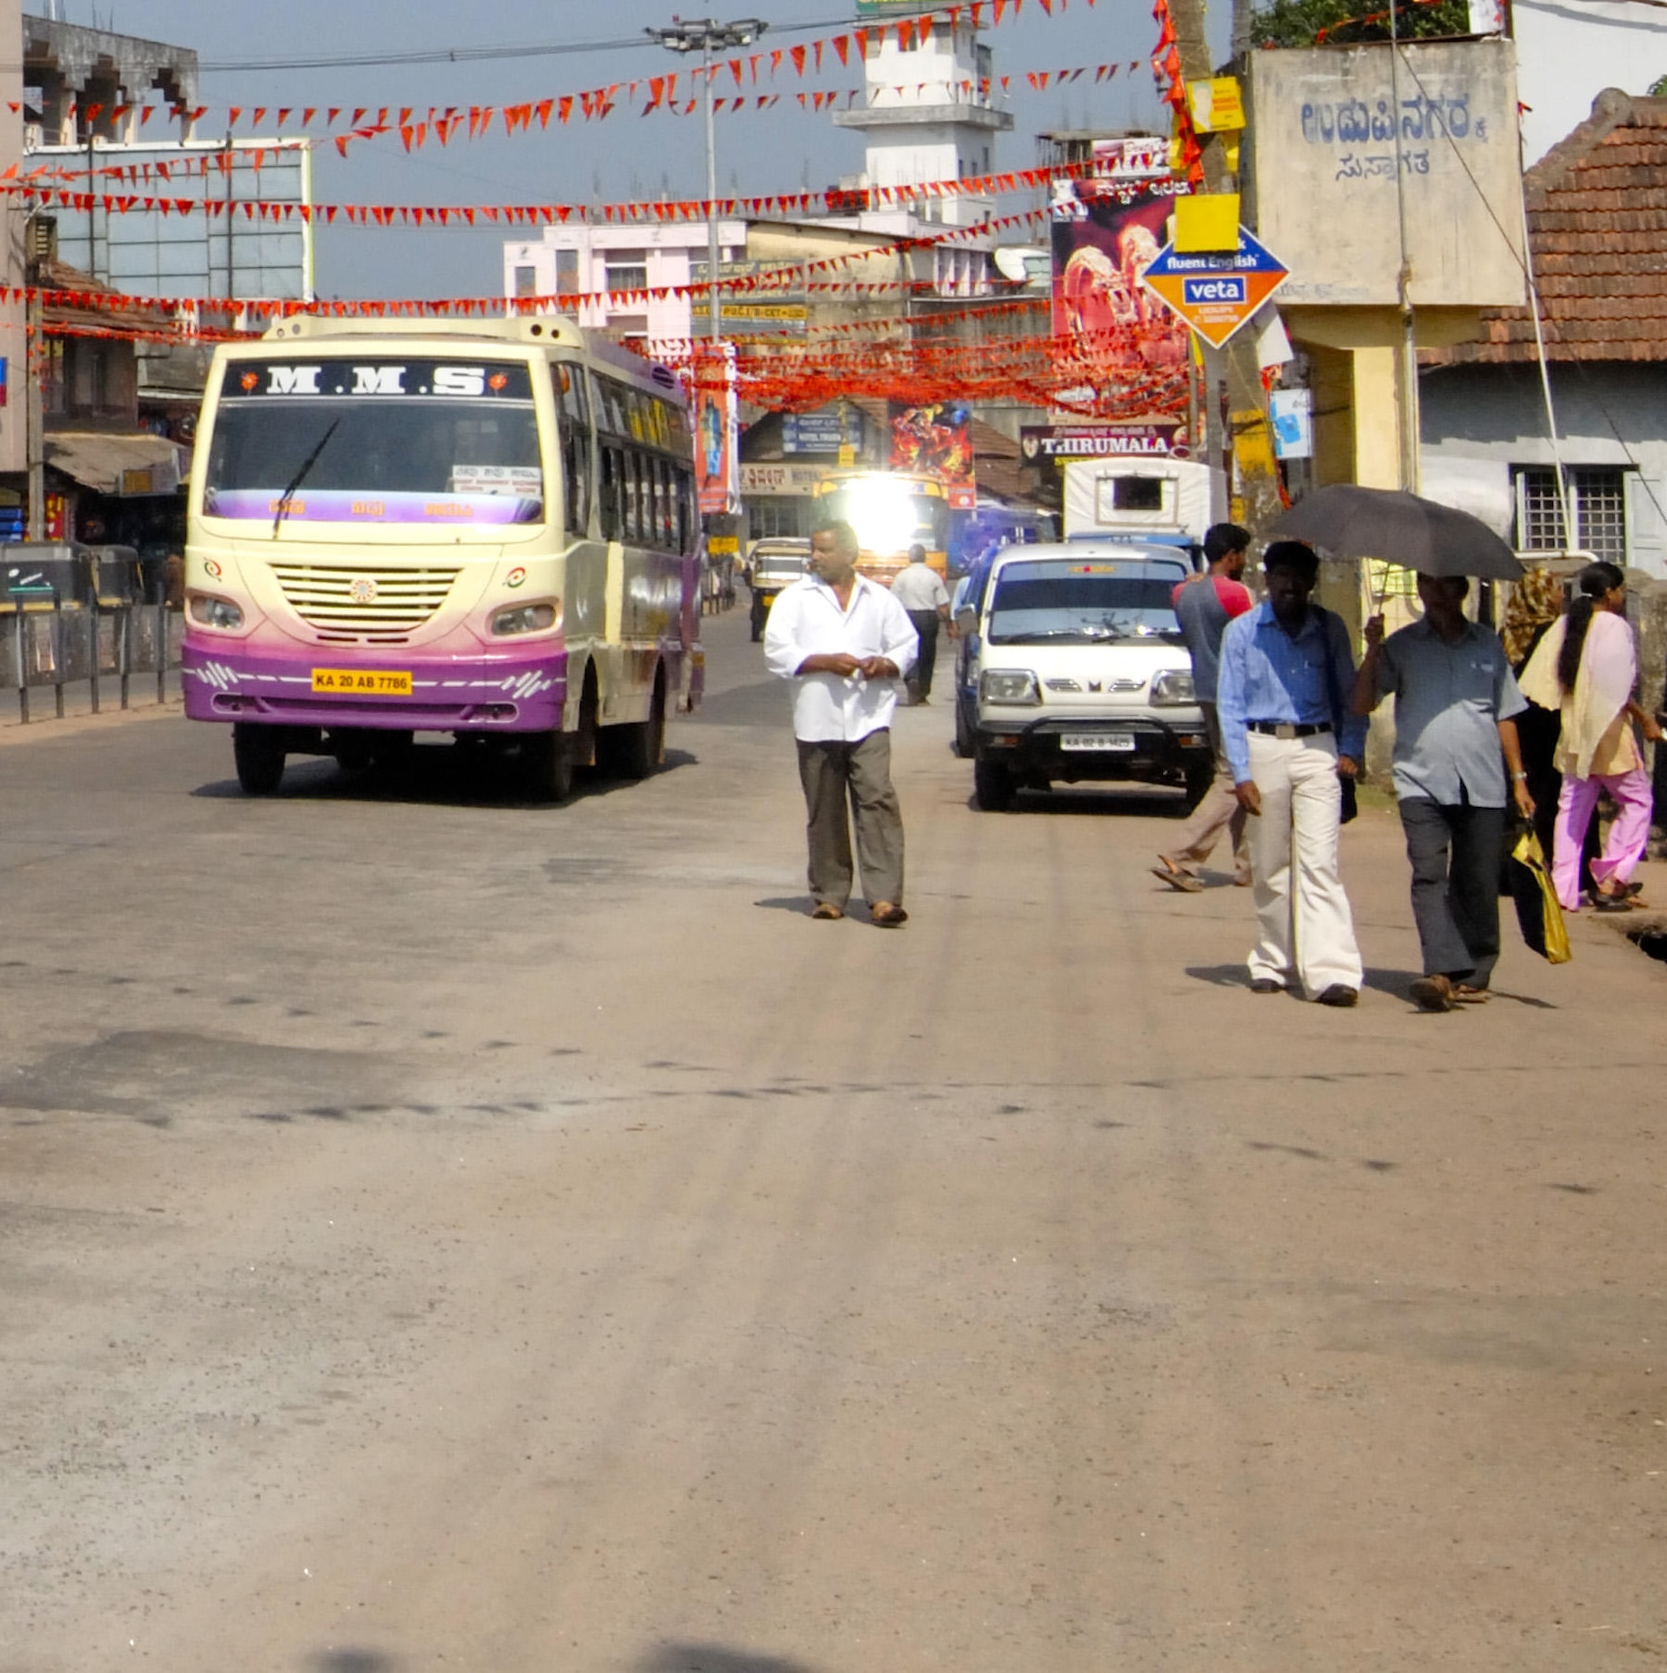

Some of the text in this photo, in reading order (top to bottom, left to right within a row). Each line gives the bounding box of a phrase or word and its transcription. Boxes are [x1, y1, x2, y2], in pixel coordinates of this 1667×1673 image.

[1167, 256, 1206, 269] fluent
[1190, 280, 1240, 299] veta
[317, 674, 334, 687] KA
[339, 675, 353, 687] 20
[357, 676, 374, 689] AB
